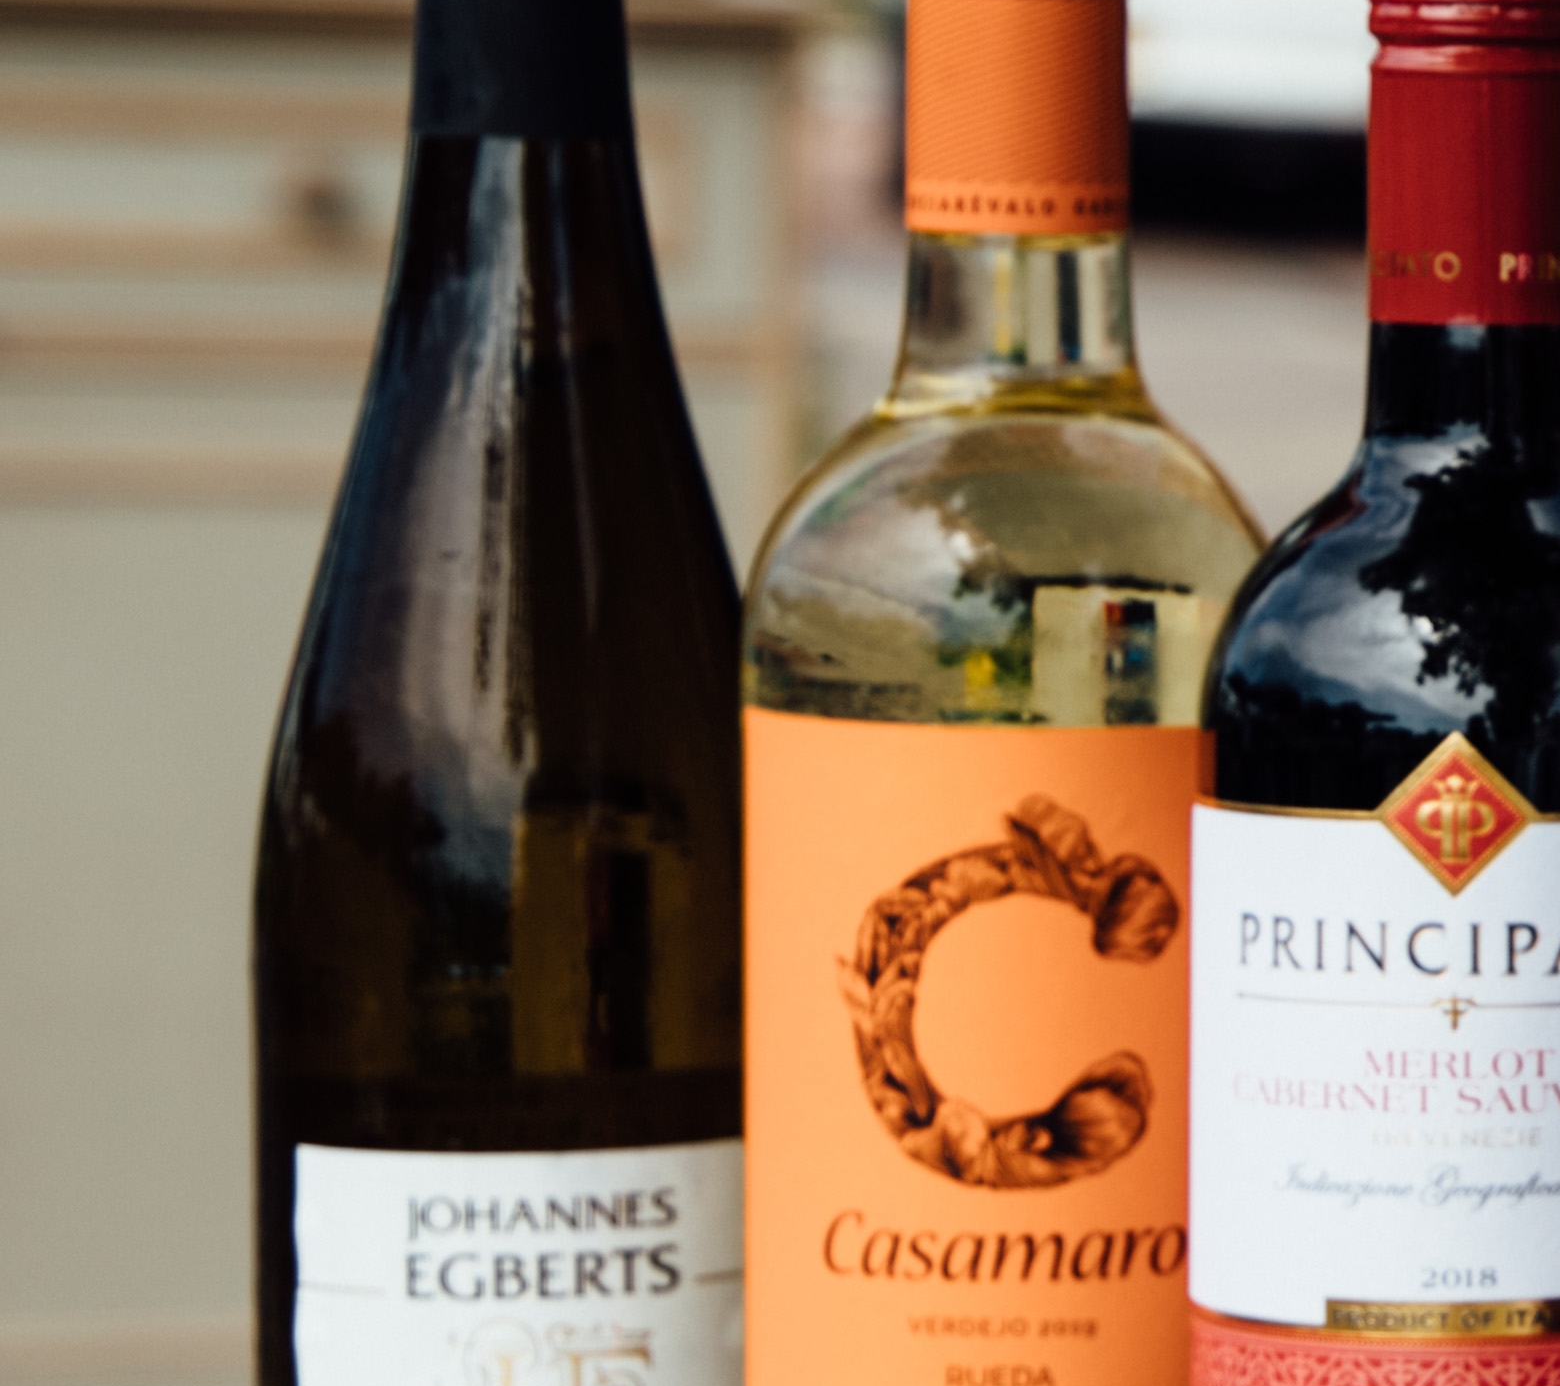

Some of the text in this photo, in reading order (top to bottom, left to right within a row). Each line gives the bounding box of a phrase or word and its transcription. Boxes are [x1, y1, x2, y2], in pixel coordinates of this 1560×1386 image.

[1364, 1047, 1557, 1080] MERLOT
[1233, 1071, 1433, 1113] CABERNET
[1274, 1161, 1414, 1207] Indicazione
[407, 1188, 677, 1243] JOHANNES
[822, 1209, 1188, 1284] Casamaro
[405, 1244, 681, 1301] EGBERTS
[1420, 1266, 1498, 1291] 2018
[1332, 1304, 1450, 1330] PRODUCT
[1461, 1304, 1494, 1330] OF
